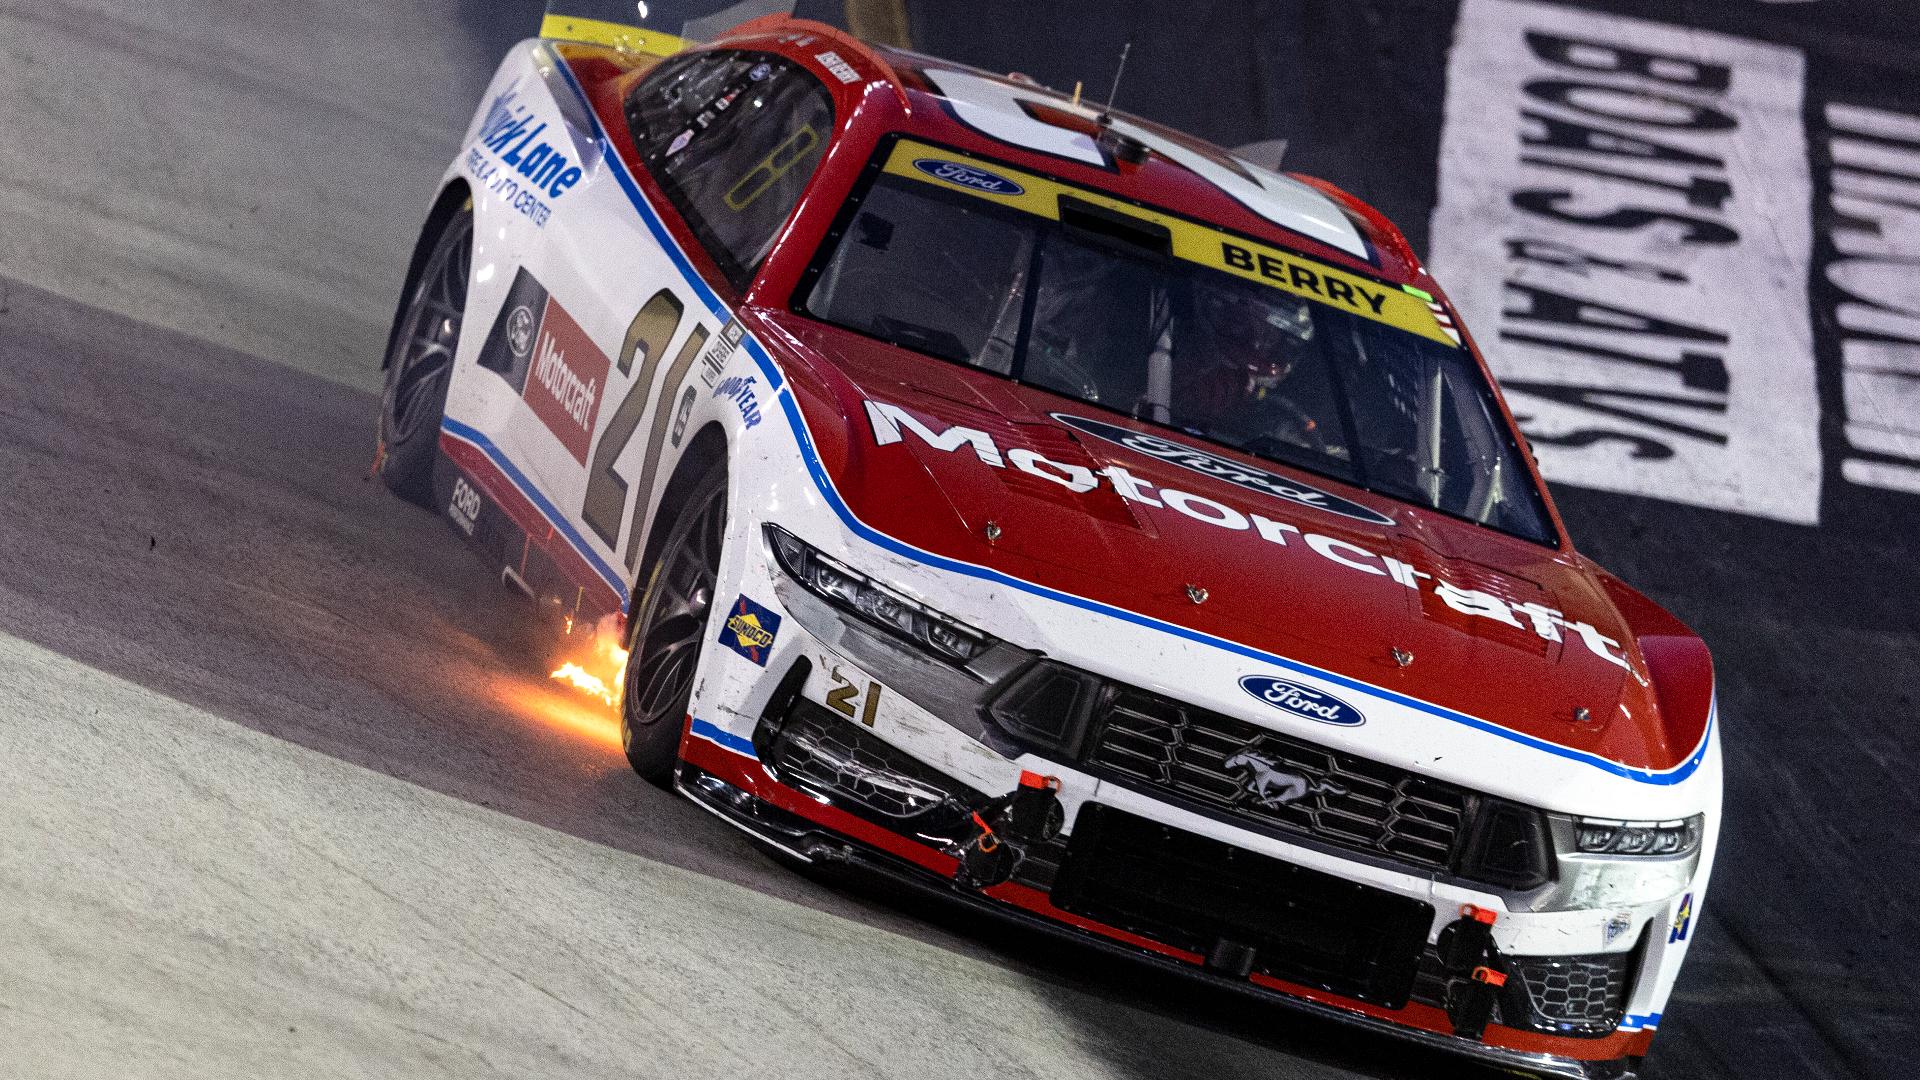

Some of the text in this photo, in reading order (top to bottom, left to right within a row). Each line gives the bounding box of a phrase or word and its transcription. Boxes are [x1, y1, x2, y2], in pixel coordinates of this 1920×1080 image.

[502, 122, 582, 199] Lane
[1508, 28, 1740, 246] BOATS
[934, 163, 1003, 190] Ford
[1221, 242, 1386, 315] BERRY
[535, 331, 596, 432] Motorcraft
[581, 287, 711, 578] 21
[1121, 435, 1329, 506] Ford
[864, 400, 1648, 688] Motorcraft
[730, 616, 772, 647] SUNOCO
[826, 664, 882, 728] 21
[1264, 682, 1341, 720] Ford
